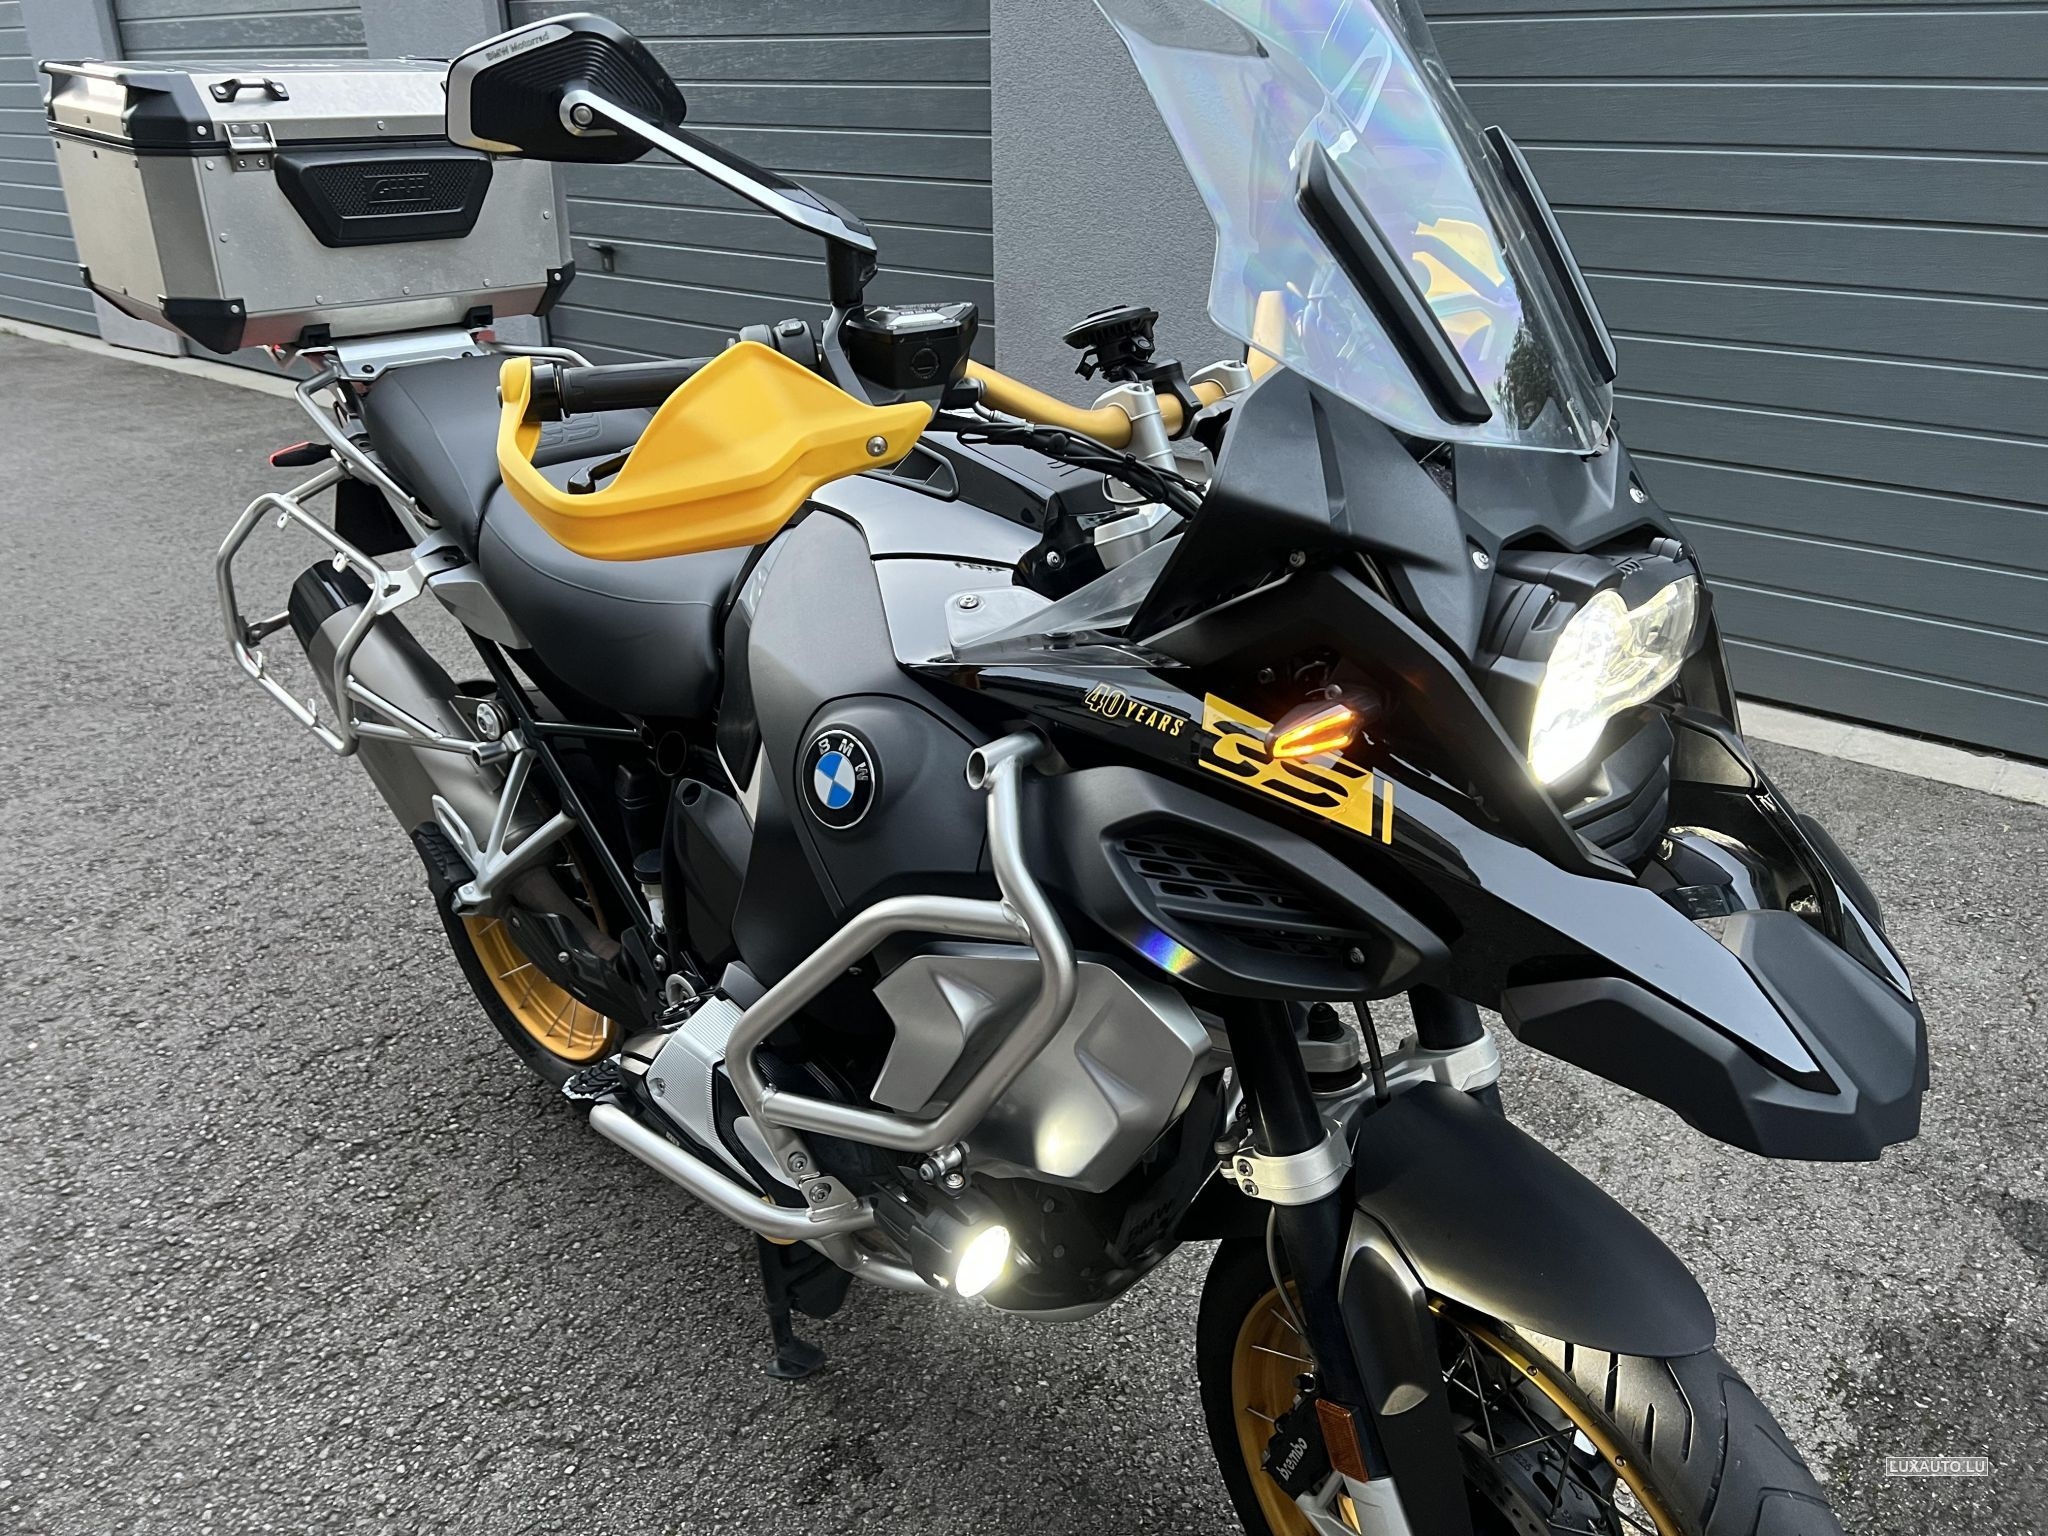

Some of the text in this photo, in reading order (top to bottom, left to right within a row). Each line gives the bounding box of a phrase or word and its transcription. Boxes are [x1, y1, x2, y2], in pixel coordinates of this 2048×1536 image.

[485, 45, 509, 61] BMW
[1085, 682, 1184, 737] 40 YEARS
[818, 738, 869, 781] BMW
[1275, 1437, 1308, 1481] brembo
